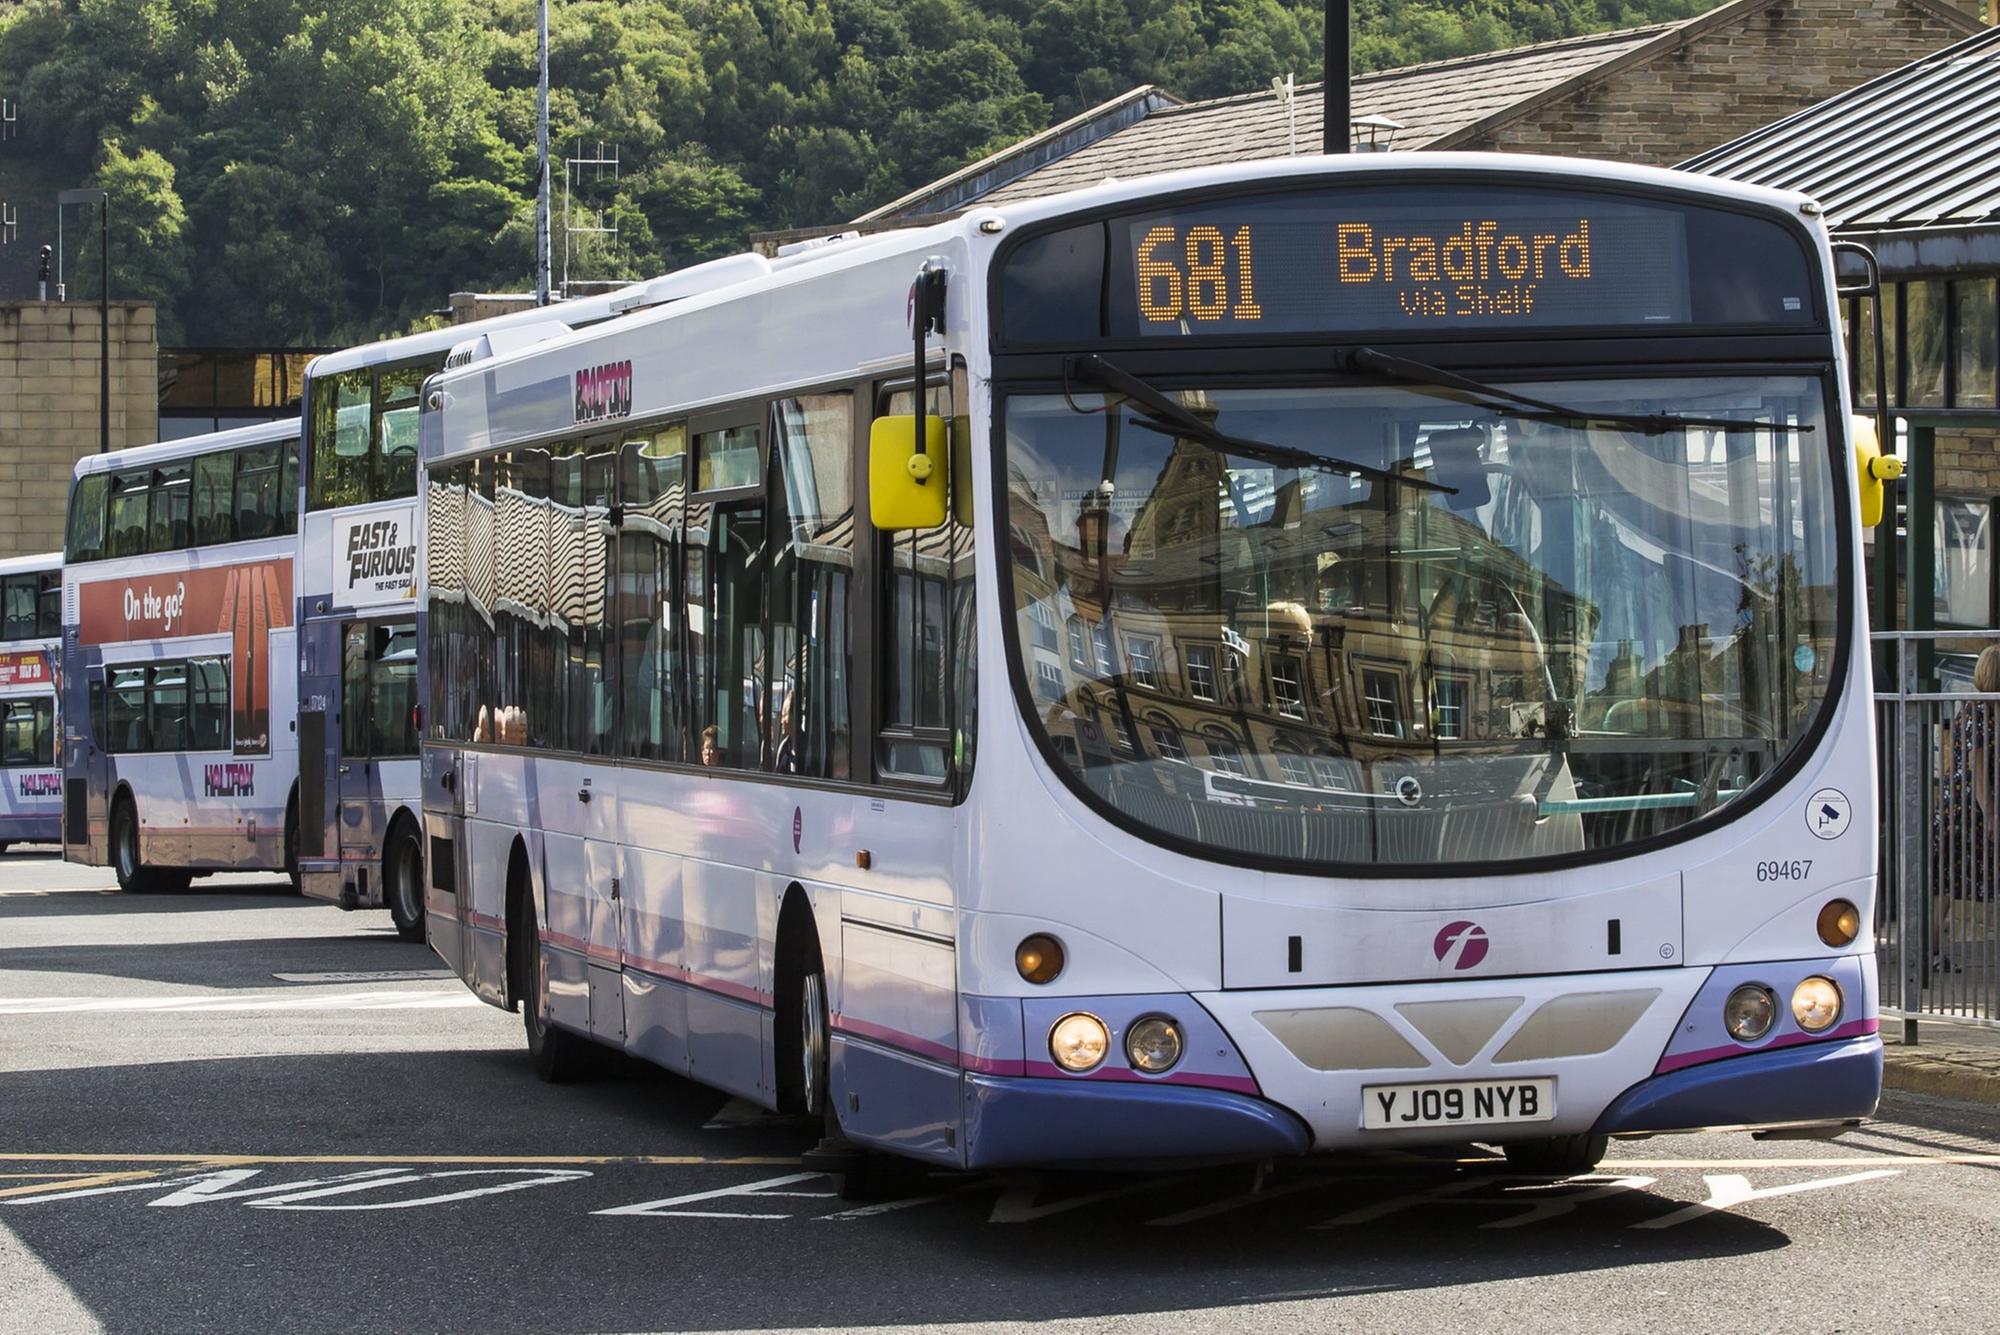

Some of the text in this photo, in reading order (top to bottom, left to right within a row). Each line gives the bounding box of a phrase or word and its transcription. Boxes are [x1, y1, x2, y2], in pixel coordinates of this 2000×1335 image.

[1338, 217, 1591, 283] Bradford
[1137, 223, 1262, 322] 681
[1400, 282, 1536, 315] via Shelf
[346, 520, 391, 561] FAST
[348, 545, 417, 589] FURIOUS
[375, 581, 385, 592] THE
[385, 580, 398, 590] FAST
[124, 581, 186, 632] On the go?
[1756, 860, 1813, 882] 69467
[1377, 1084, 1539, 1123] YJ09 NYB
[2, 1167, 596, 1211] NO
